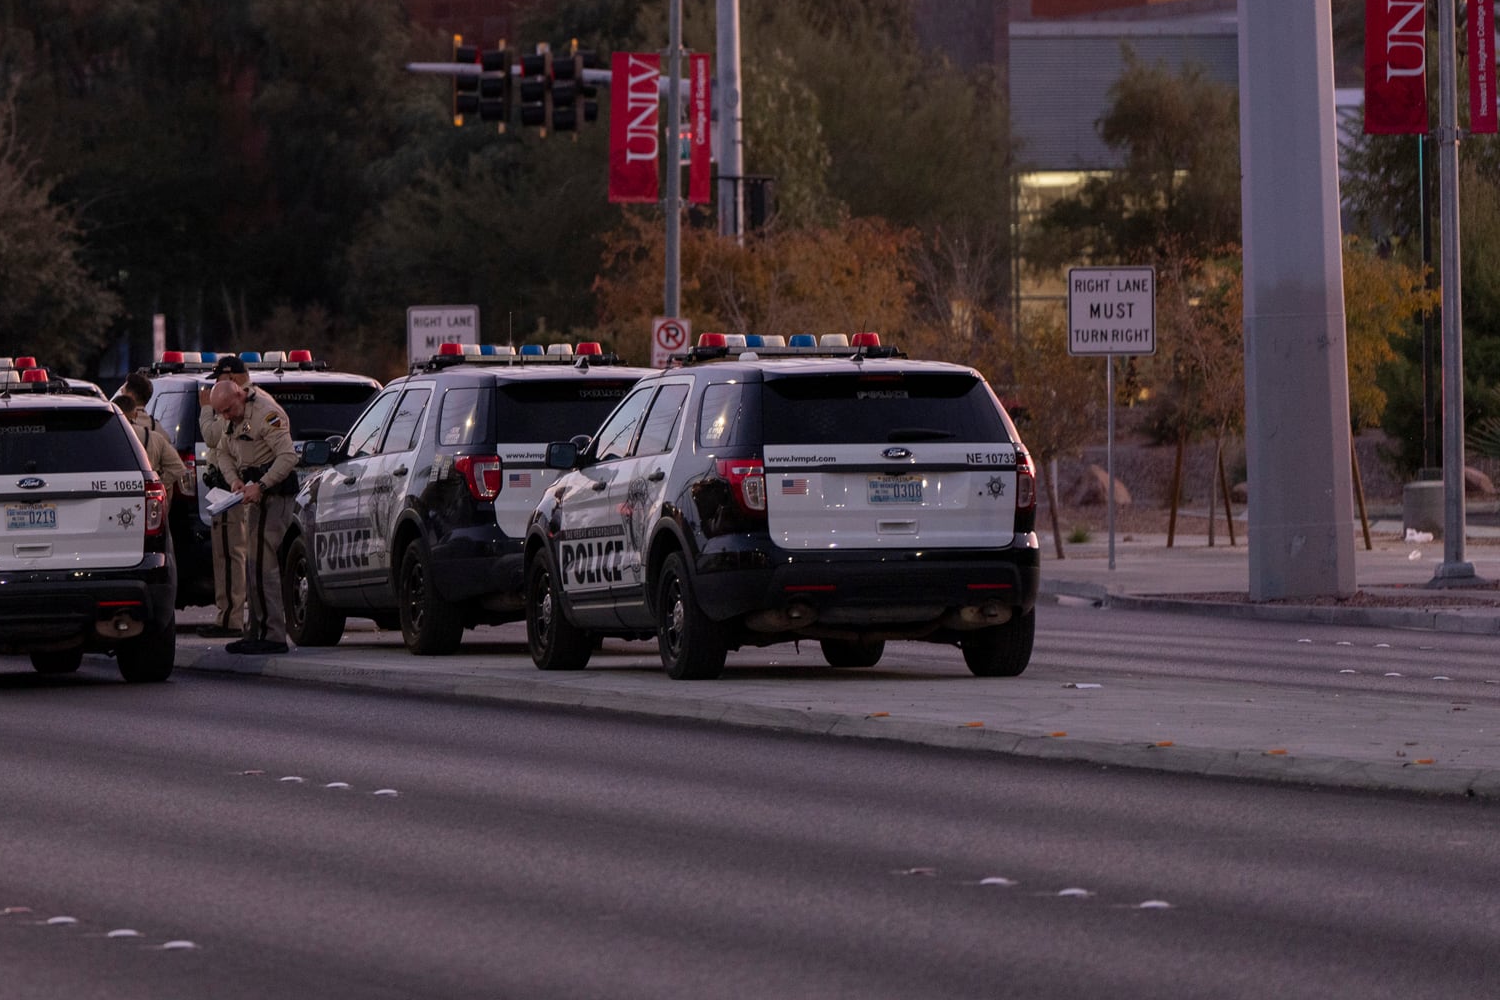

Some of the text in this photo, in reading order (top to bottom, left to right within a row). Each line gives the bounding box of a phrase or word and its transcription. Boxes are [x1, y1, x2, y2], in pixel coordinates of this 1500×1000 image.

[1476, 5, 1487, 38] College
[1478, 38, 1488, 71] Hughes
[1479, 82, 1488, 116] Howard
[626, 54, 660, 165] UNLV
[1075, 279, 1148, 292] RIGHT LANE
[1089, 302, 1134, 319] MUST
[413, 316, 473, 328] RIGHT LANE
[1074, 329, 1149, 343] TURN RIGHT
[768, 455, 837, 464] www.lvmpd.com
[966, 453, 1017, 463] NE 10733
[92, 479, 144, 491] NE 10654
[894, 483, 922, 498] 0308
[29, 510, 56, 525] 0219
[316, 530, 370, 570] POLICE
[562, 541, 624, 584] POLICE
